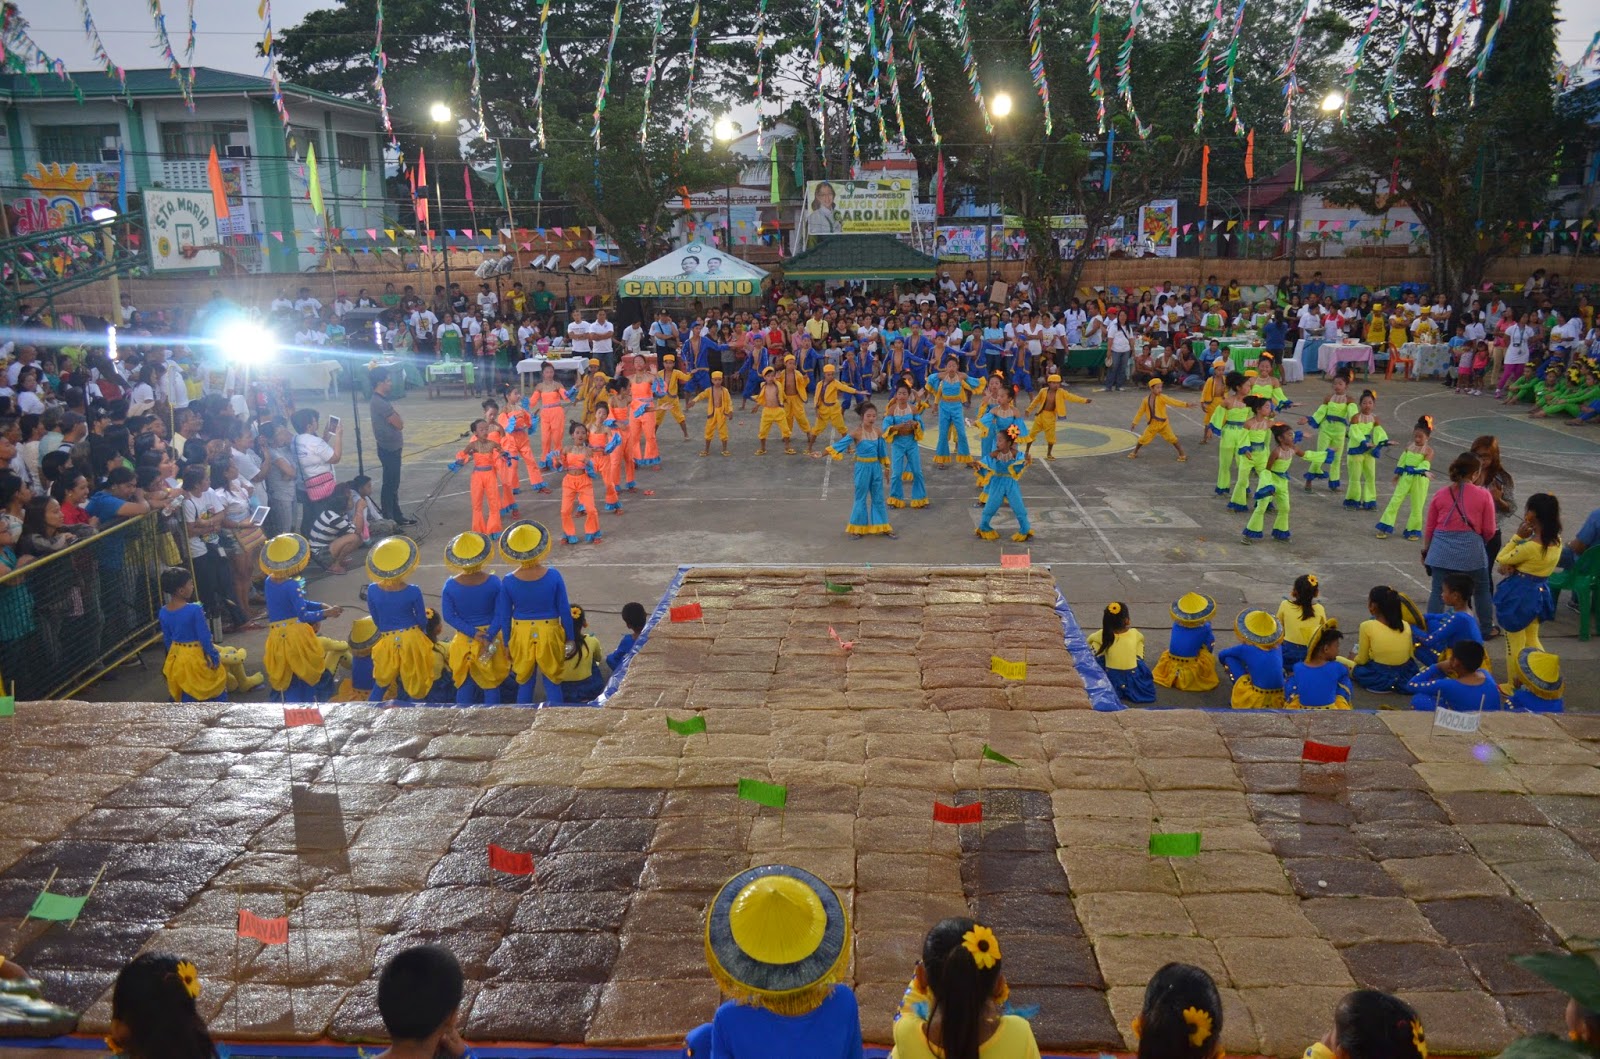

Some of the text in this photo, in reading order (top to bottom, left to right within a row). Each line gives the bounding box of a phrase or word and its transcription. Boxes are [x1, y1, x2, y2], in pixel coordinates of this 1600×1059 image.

[177, 197, 210, 230] MARIA
[833, 209, 910, 222] CAROLINO
[624, 280, 753, 296] CAROLINO
